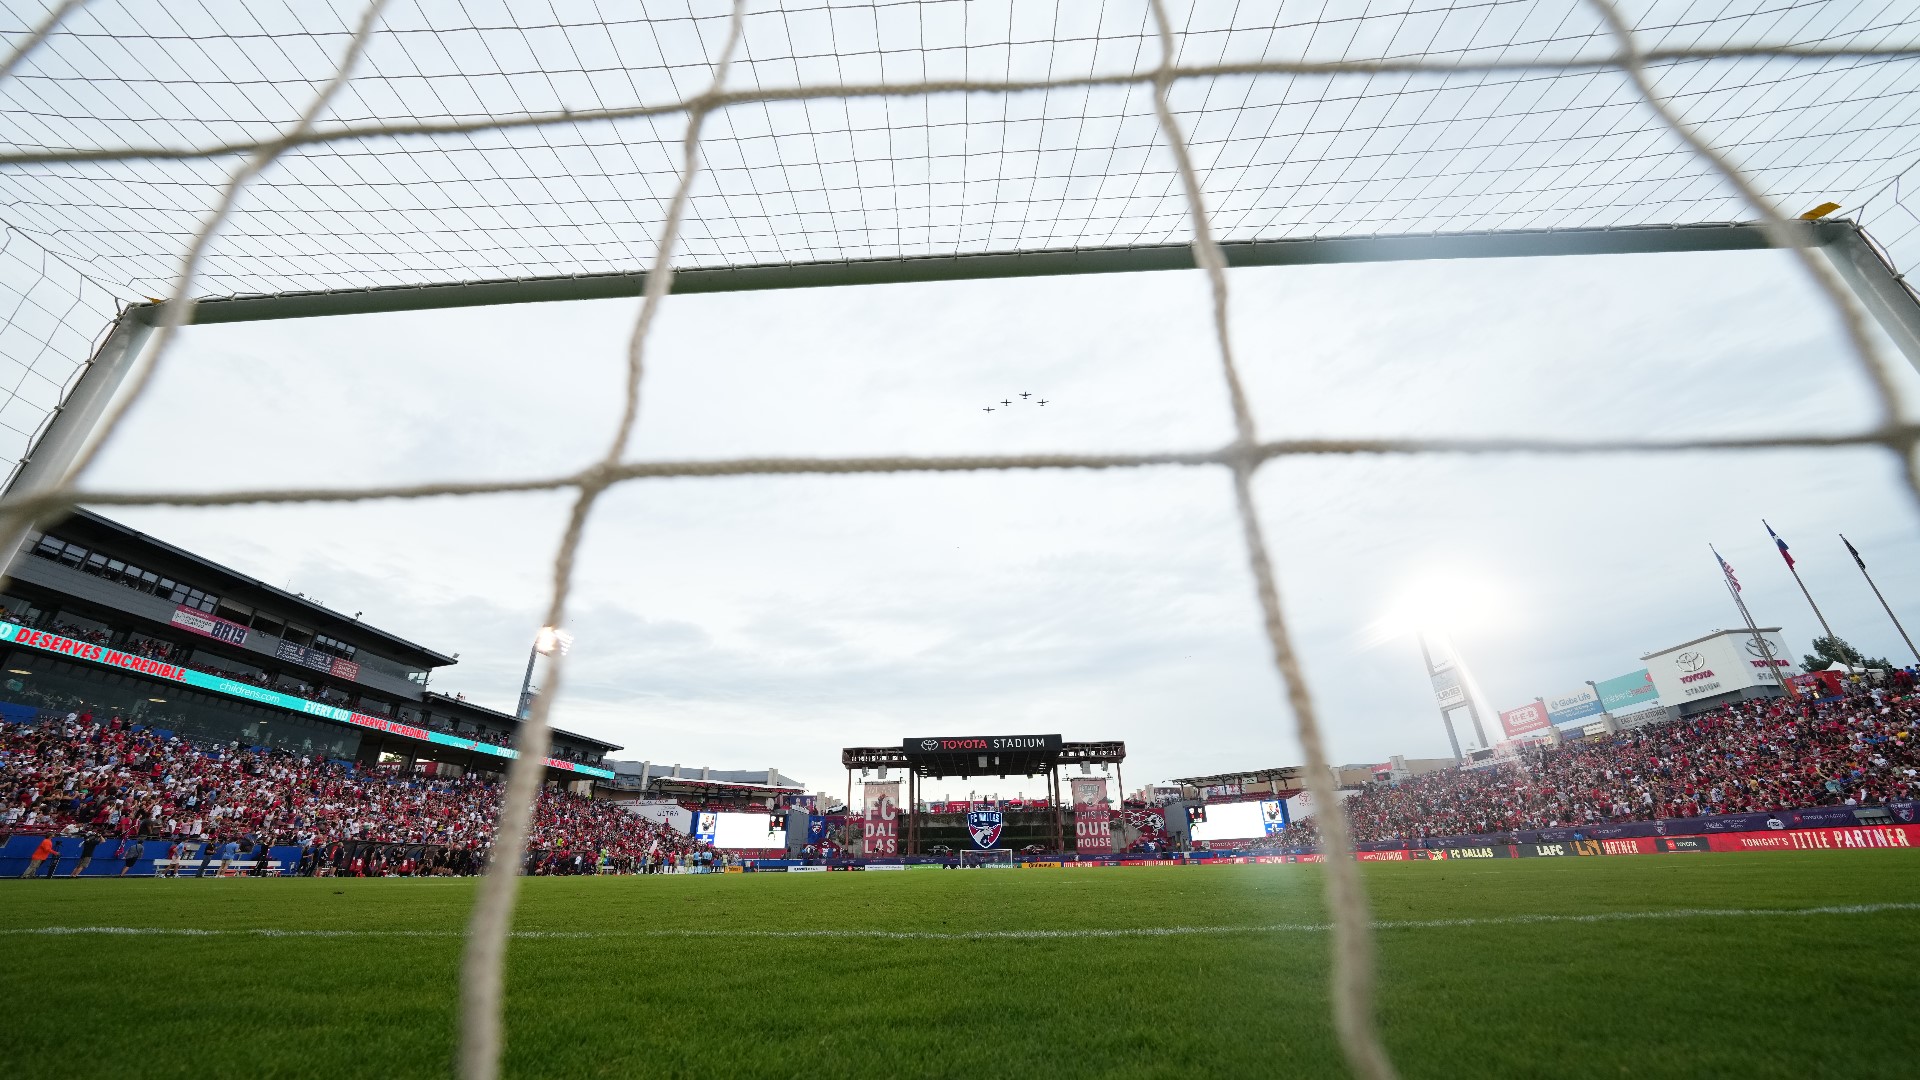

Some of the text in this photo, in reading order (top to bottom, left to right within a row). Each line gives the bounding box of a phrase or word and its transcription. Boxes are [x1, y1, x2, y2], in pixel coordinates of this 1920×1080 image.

[15, 628, 103, 661] DESERVES
[103, 650, 187, 681] INCREDIBLE.
[1680, 669, 1715, 684] TOYOTA
[219, 682, 280, 704] childrens.com
[1685, 681, 1721, 696] STADIUM
[1558, 697, 1579, 707] Globe
[1579, 692, 1591, 702] Life
[304, 701, 431, 740] EVERY KID DESERVES INCREDIBLE.
[941, 738, 1045, 749] TOYOTA STADIUM
[866, 797, 896, 820] FC
[1075, 811, 1096, 819] THIS
[970, 813, 978, 823] FC
[866, 823, 896, 837] DAL
[1077, 821, 1110, 836] OUR
[865, 838, 895, 854] LAS
[1077, 838, 1111, 847] HOUSE
[1741, 828, 1910, 849] TONIGHT'S TITLE PARTNER
[1450, 849, 1461, 858] FC
[1462, 848, 1493, 858] DALLAS
[1536, 844, 1564, 856] LAFC
